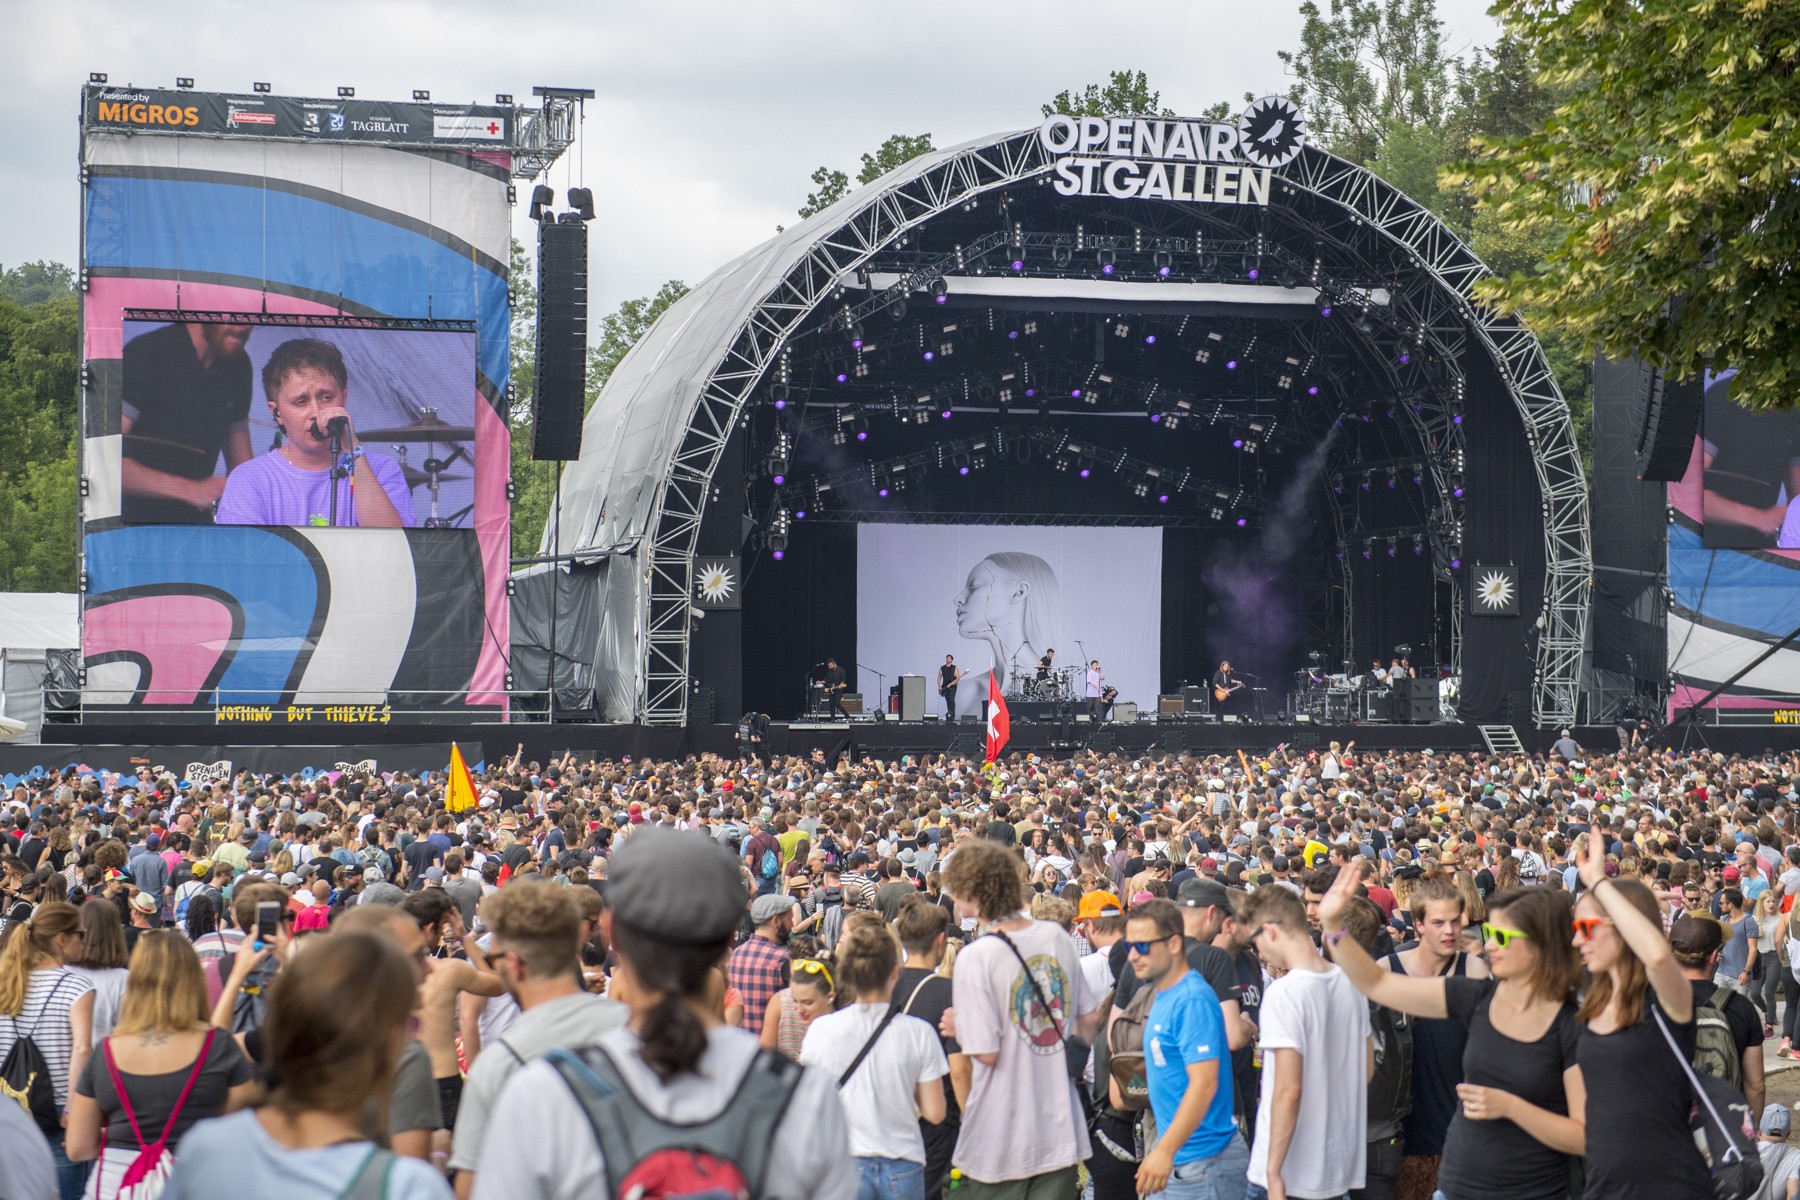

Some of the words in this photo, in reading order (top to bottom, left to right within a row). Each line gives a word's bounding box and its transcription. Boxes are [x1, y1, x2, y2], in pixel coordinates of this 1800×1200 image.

[100, 92, 138, 101] Presented
[138, 94, 150, 103] by
[98, 101, 199, 126] MIGROS
[351, 120, 409, 134] TAGBLATT
[1040, 114, 1238, 163] OPENAIR
[216, 705, 273, 722] NOTHING
[287, 706, 314, 722] BUT
[325, 705, 391, 723] THIEVES
[188, 763, 224, 775] OPENAIR
